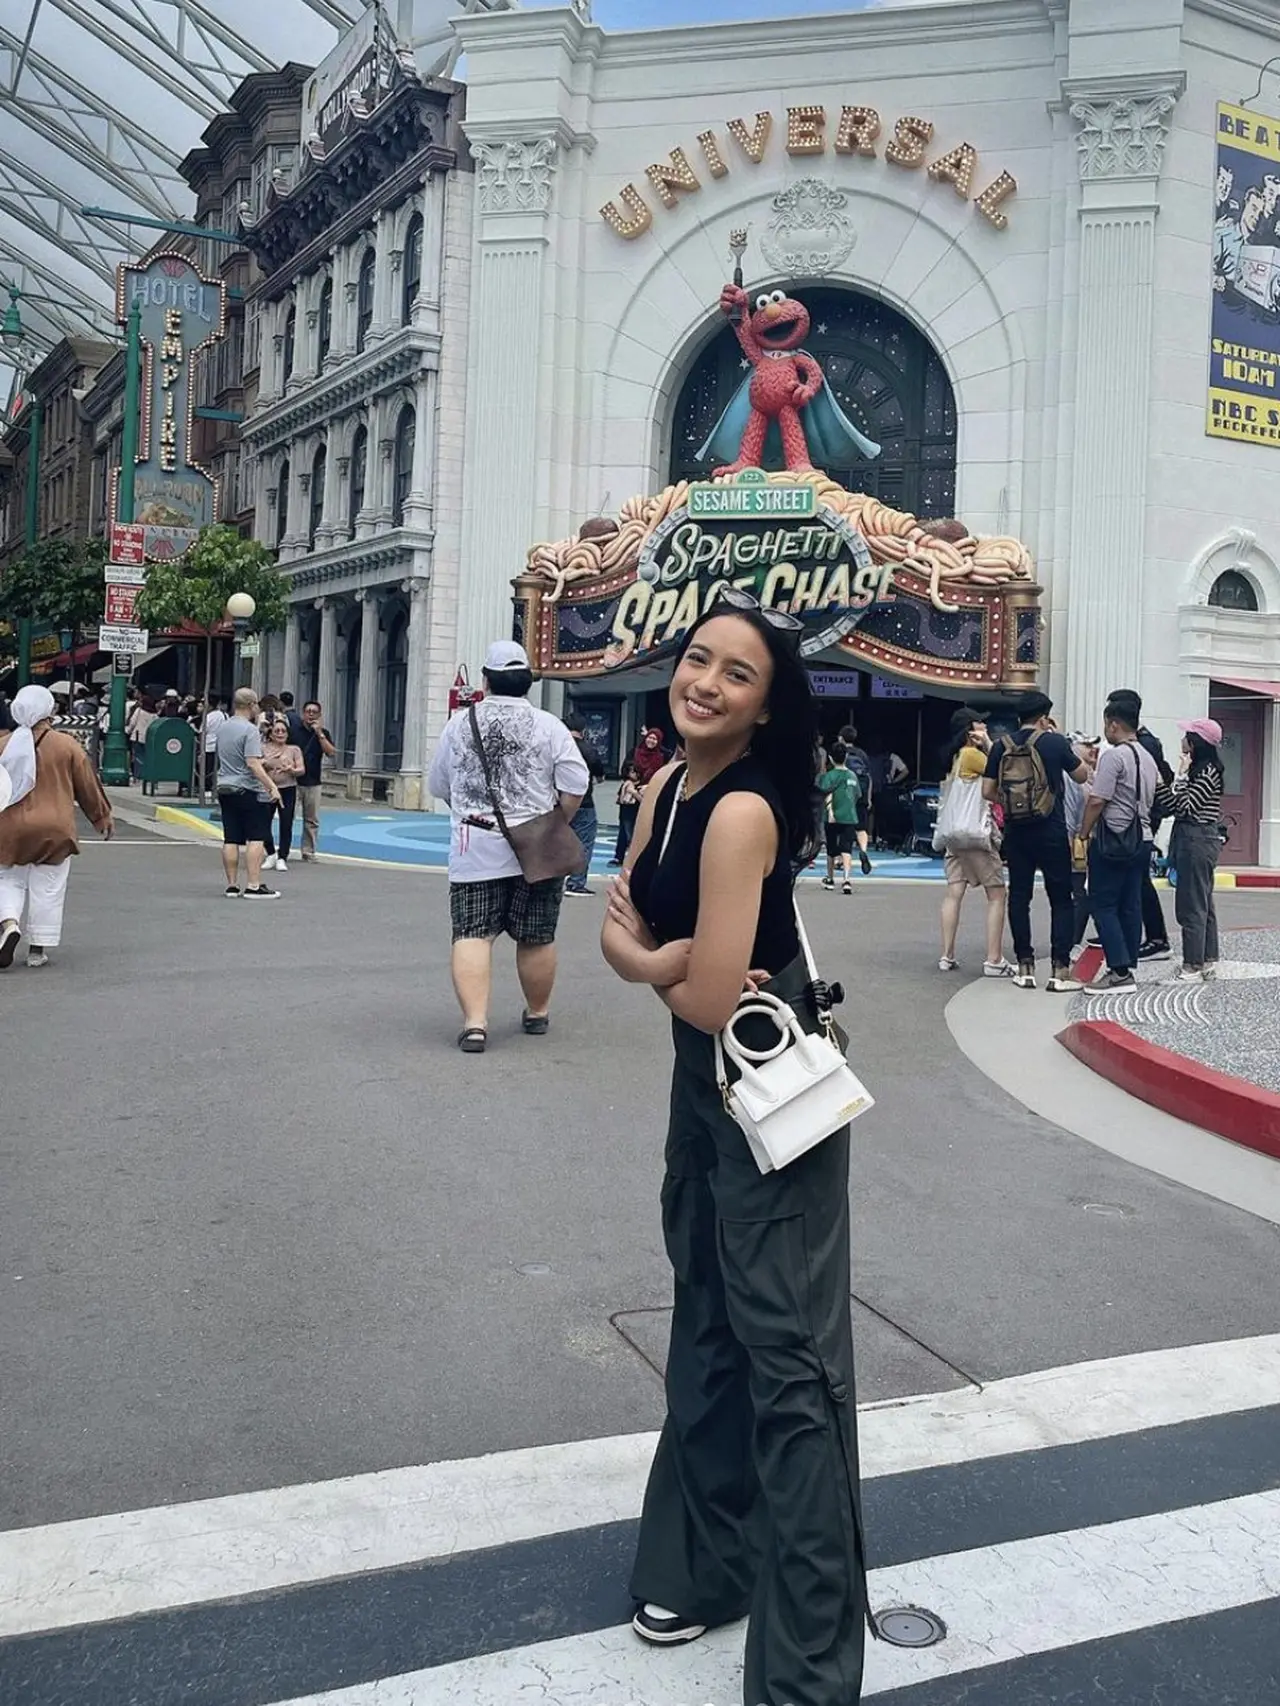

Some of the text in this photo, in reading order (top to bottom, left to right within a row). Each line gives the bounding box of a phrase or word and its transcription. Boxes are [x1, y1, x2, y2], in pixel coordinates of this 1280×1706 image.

[600, 105, 1017, 239] UNIVERSAL
[132, 275, 211, 324] HOTEL
[1211, 337, 1280, 368] SATURDA
[161, 308, 183, 472] EMPIRE
[1212, 398, 1257, 422] NBC
[1213, 418, 1280, 440] ROCKEFE
[694, 487, 811, 513] SESAME STREET
[663, 523, 844, 583] SPAGHETTI
[603, 561, 898, 668] SPA CHASE
[101, 635, 146, 646] COMMERCIAL
[110, 643, 138, 651] TRAFFIC
